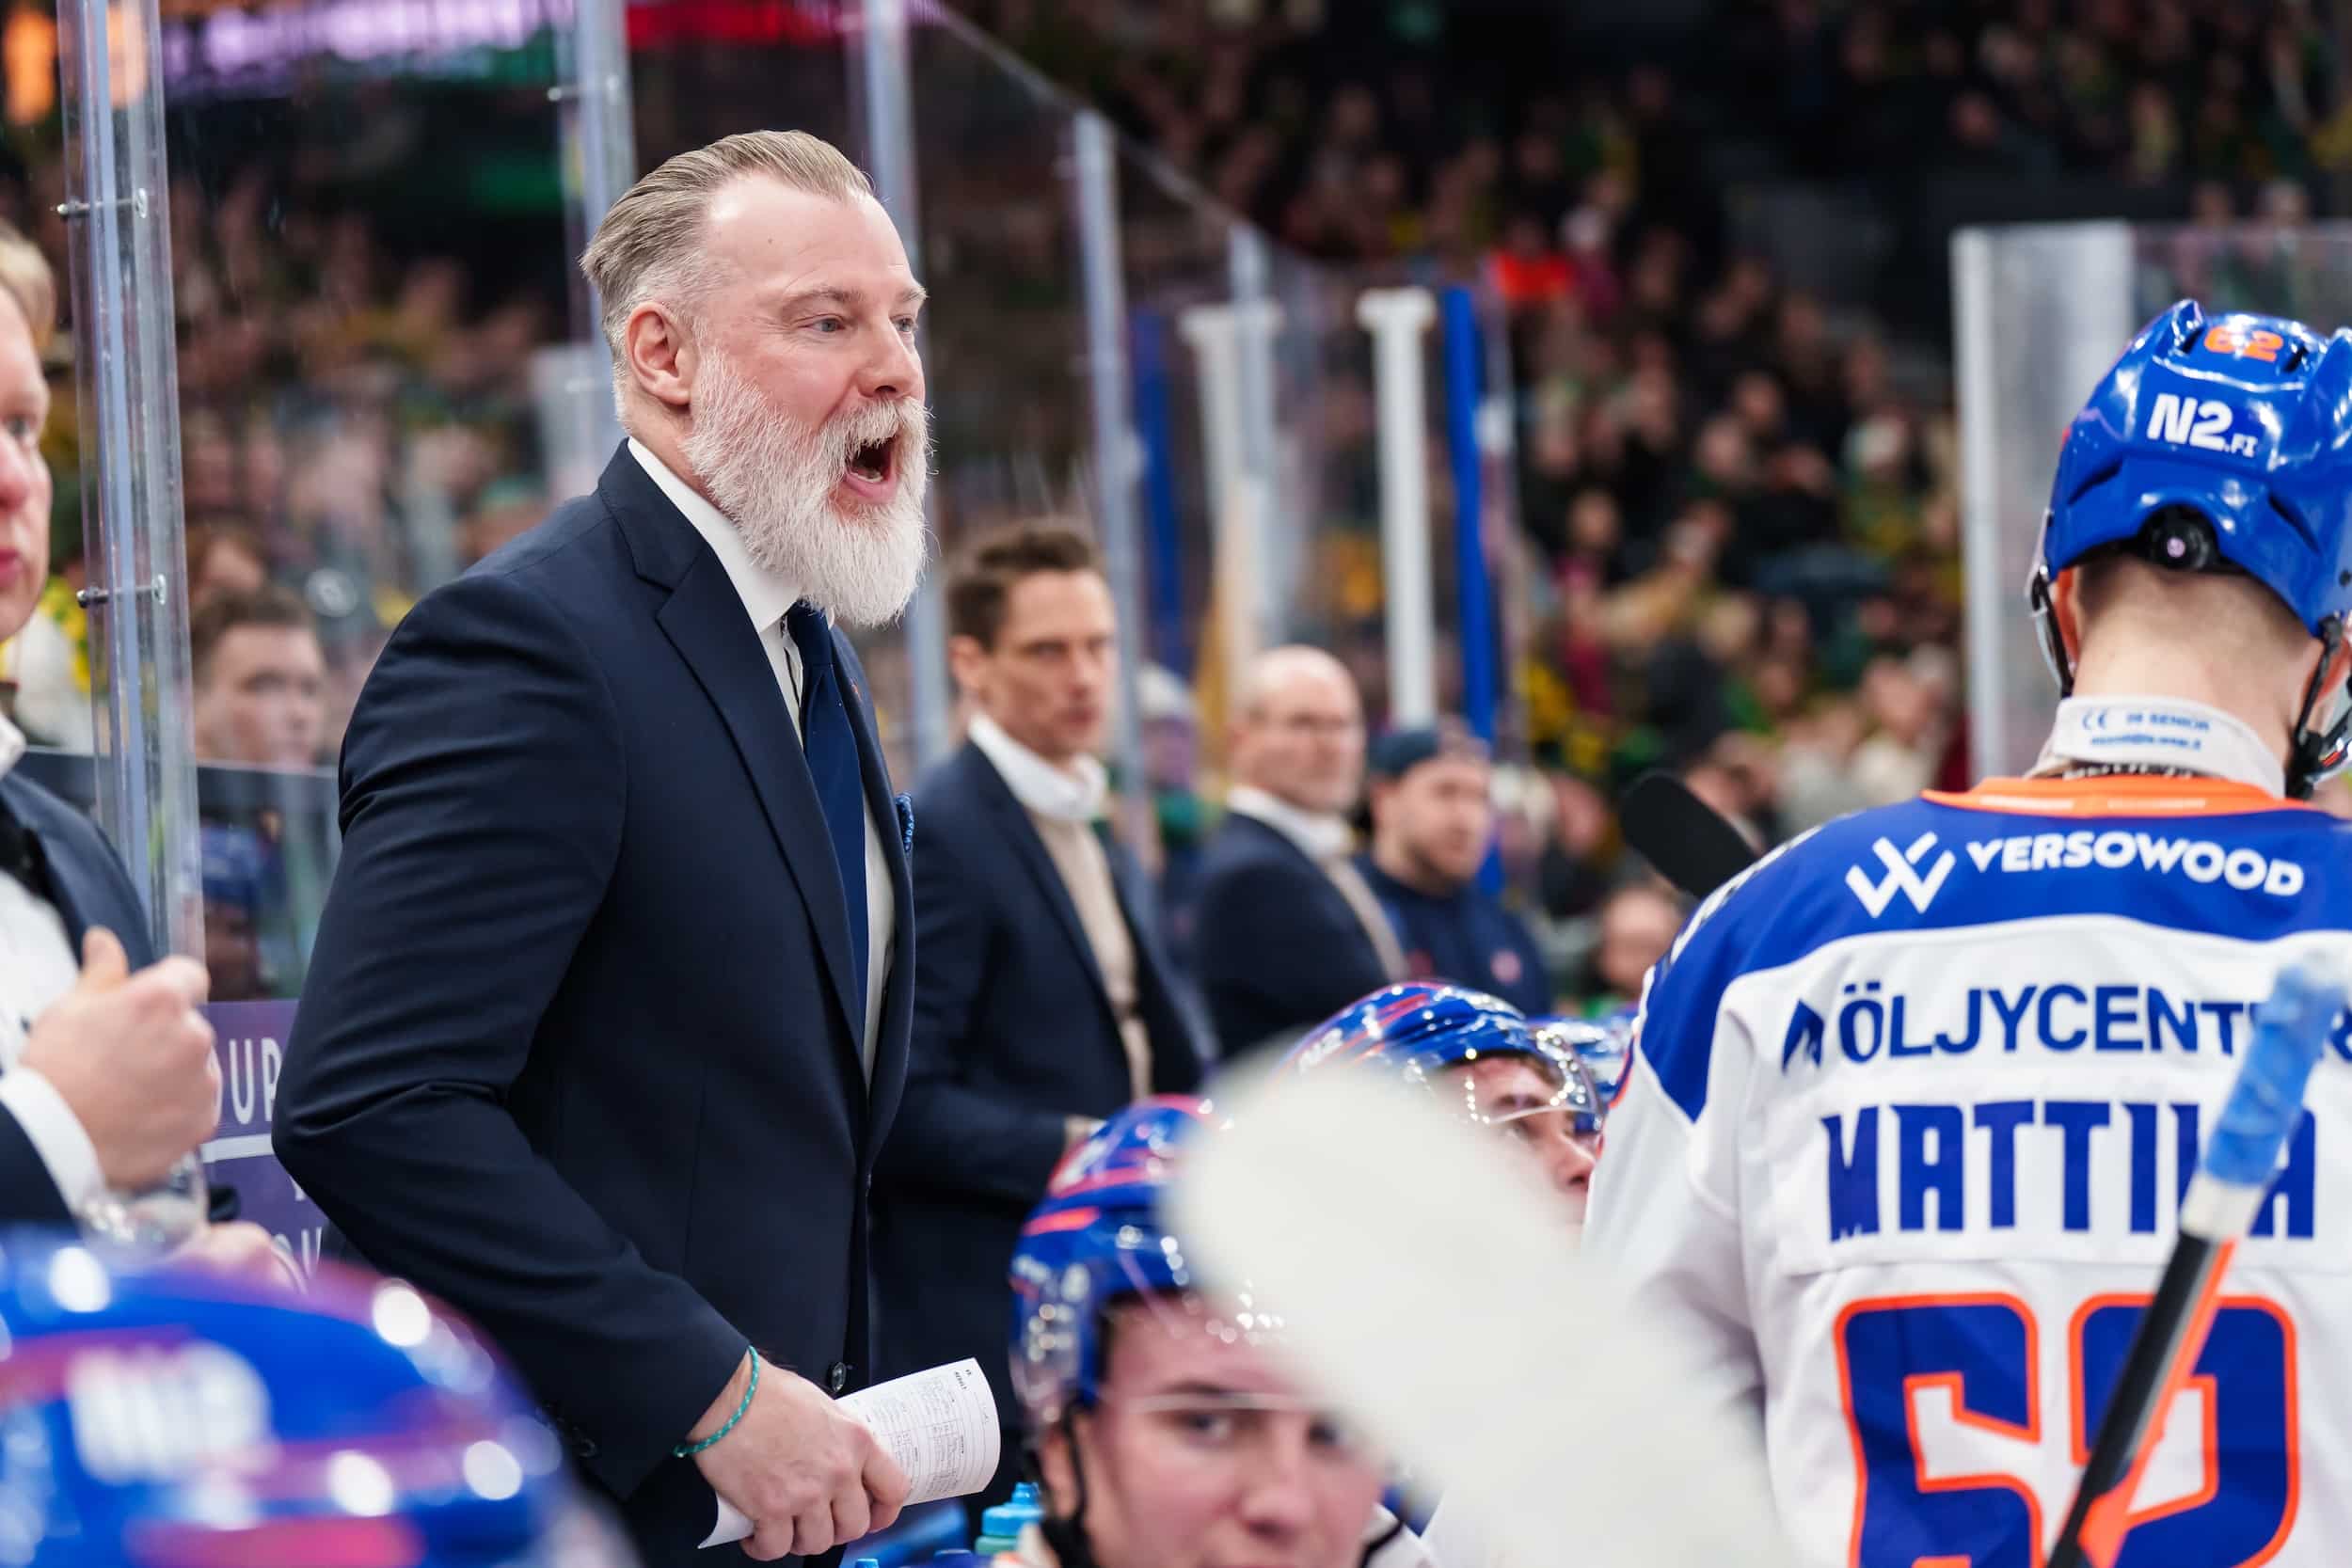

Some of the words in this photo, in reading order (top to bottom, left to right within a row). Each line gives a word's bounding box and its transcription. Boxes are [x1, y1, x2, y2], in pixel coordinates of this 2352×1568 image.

[2203, 325, 2284, 363] 62
[1965, 831, 2305, 896] VERSOWOOD
[1838, 981, 2352, 1064] ÖLJYCENT
